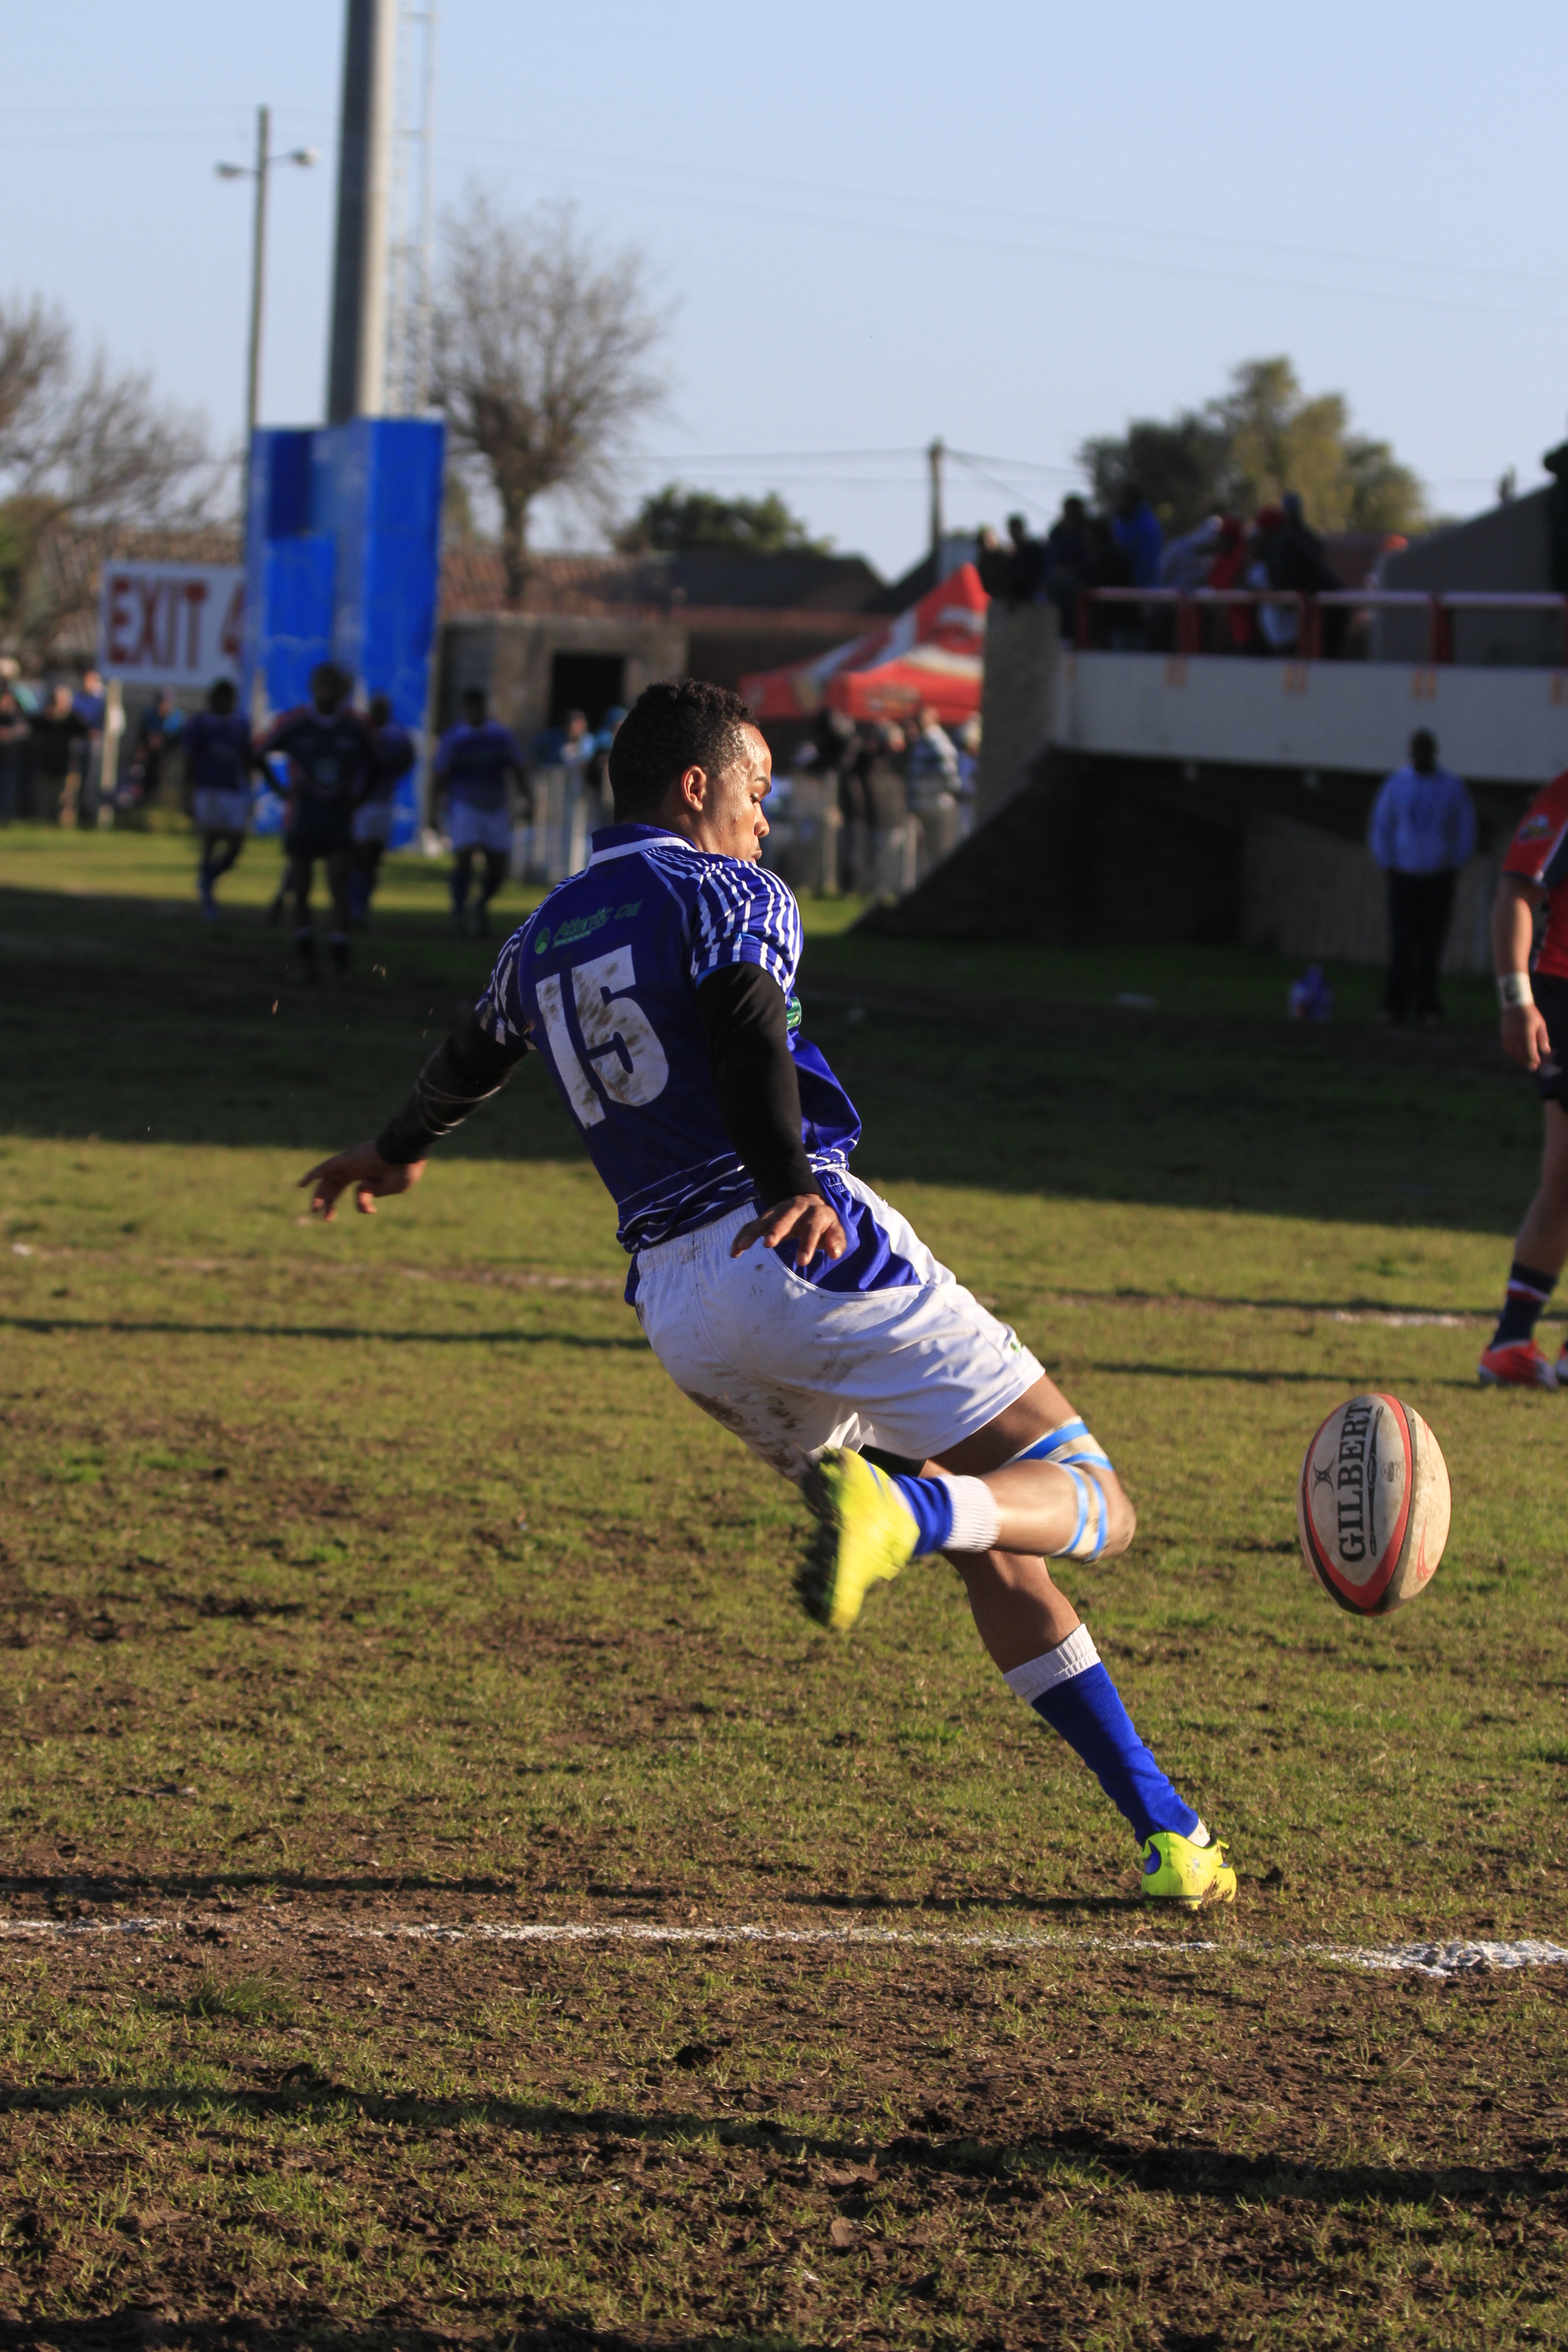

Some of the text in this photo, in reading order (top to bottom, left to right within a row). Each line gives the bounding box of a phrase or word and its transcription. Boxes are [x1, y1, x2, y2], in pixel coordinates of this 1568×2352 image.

[109, 576, 208, 669] EXIT
[535, 944, 670, 1130] 15
[1337, 1403, 1373, 1563] GILBERT
